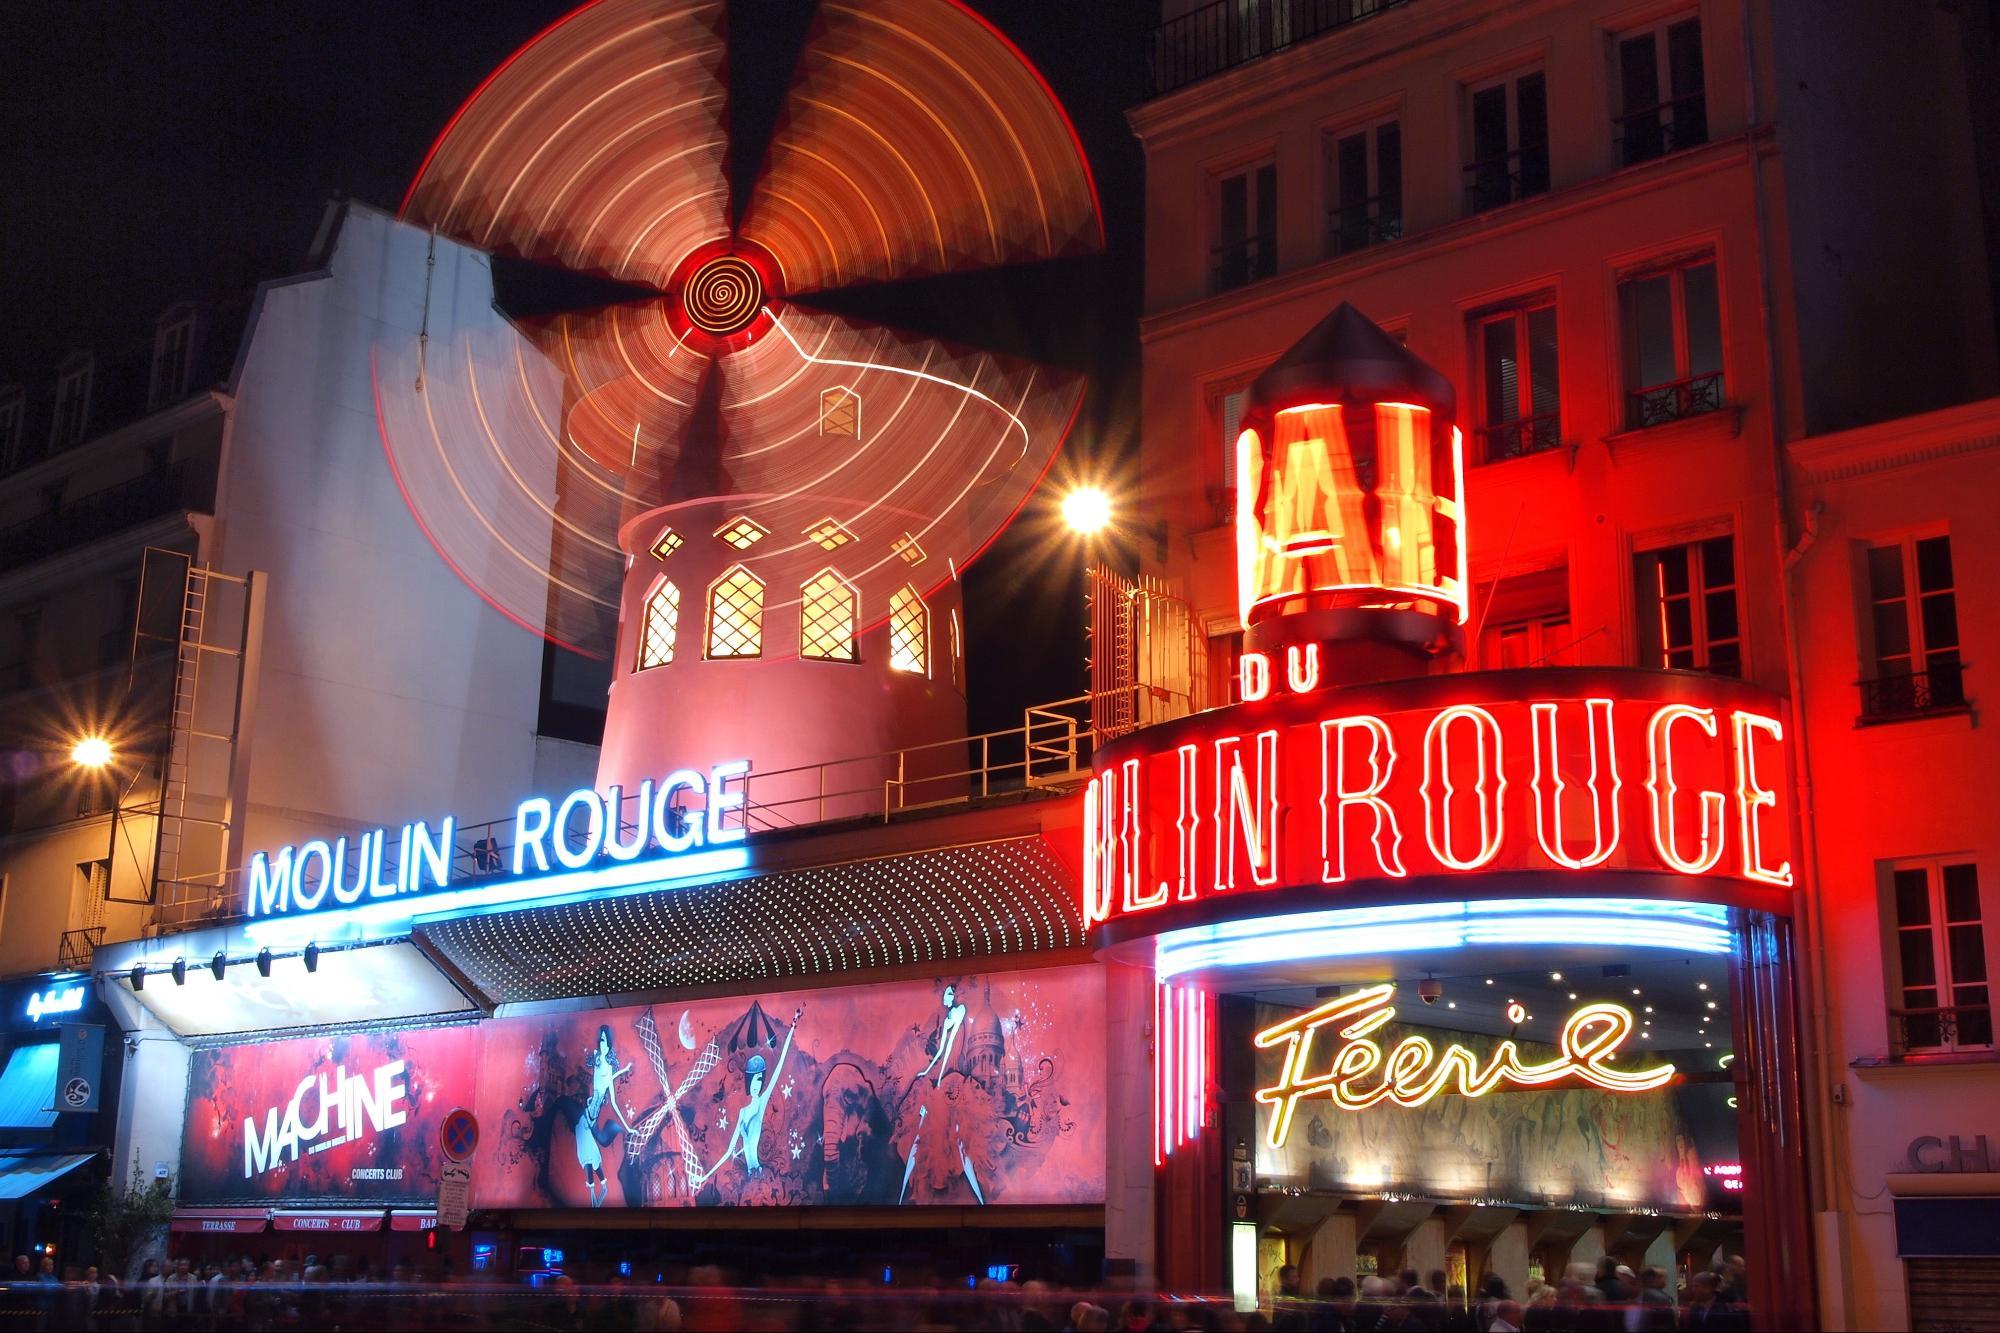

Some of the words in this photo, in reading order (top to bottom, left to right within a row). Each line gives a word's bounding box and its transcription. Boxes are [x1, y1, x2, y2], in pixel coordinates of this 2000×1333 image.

[1239, 643, 1319, 702] DU
[1319, 698, 1795, 888] ROUGE
[248, 815, 457, 916] MOULIN
[512, 760, 753, 875] ROUGE
[1255, 983, 1676, 1149] Féerie
[244, 1059, 407, 1178] MACHINE
[352, 1168, 384, 1180] CONCERTS
[386, 1168, 403, 1180] CLUB
[202, 1220, 236, 1231] TERRASSE
[293, 1218, 329, 1229] CONCERTS
[341, 1218, 361, 1229] CLUB
